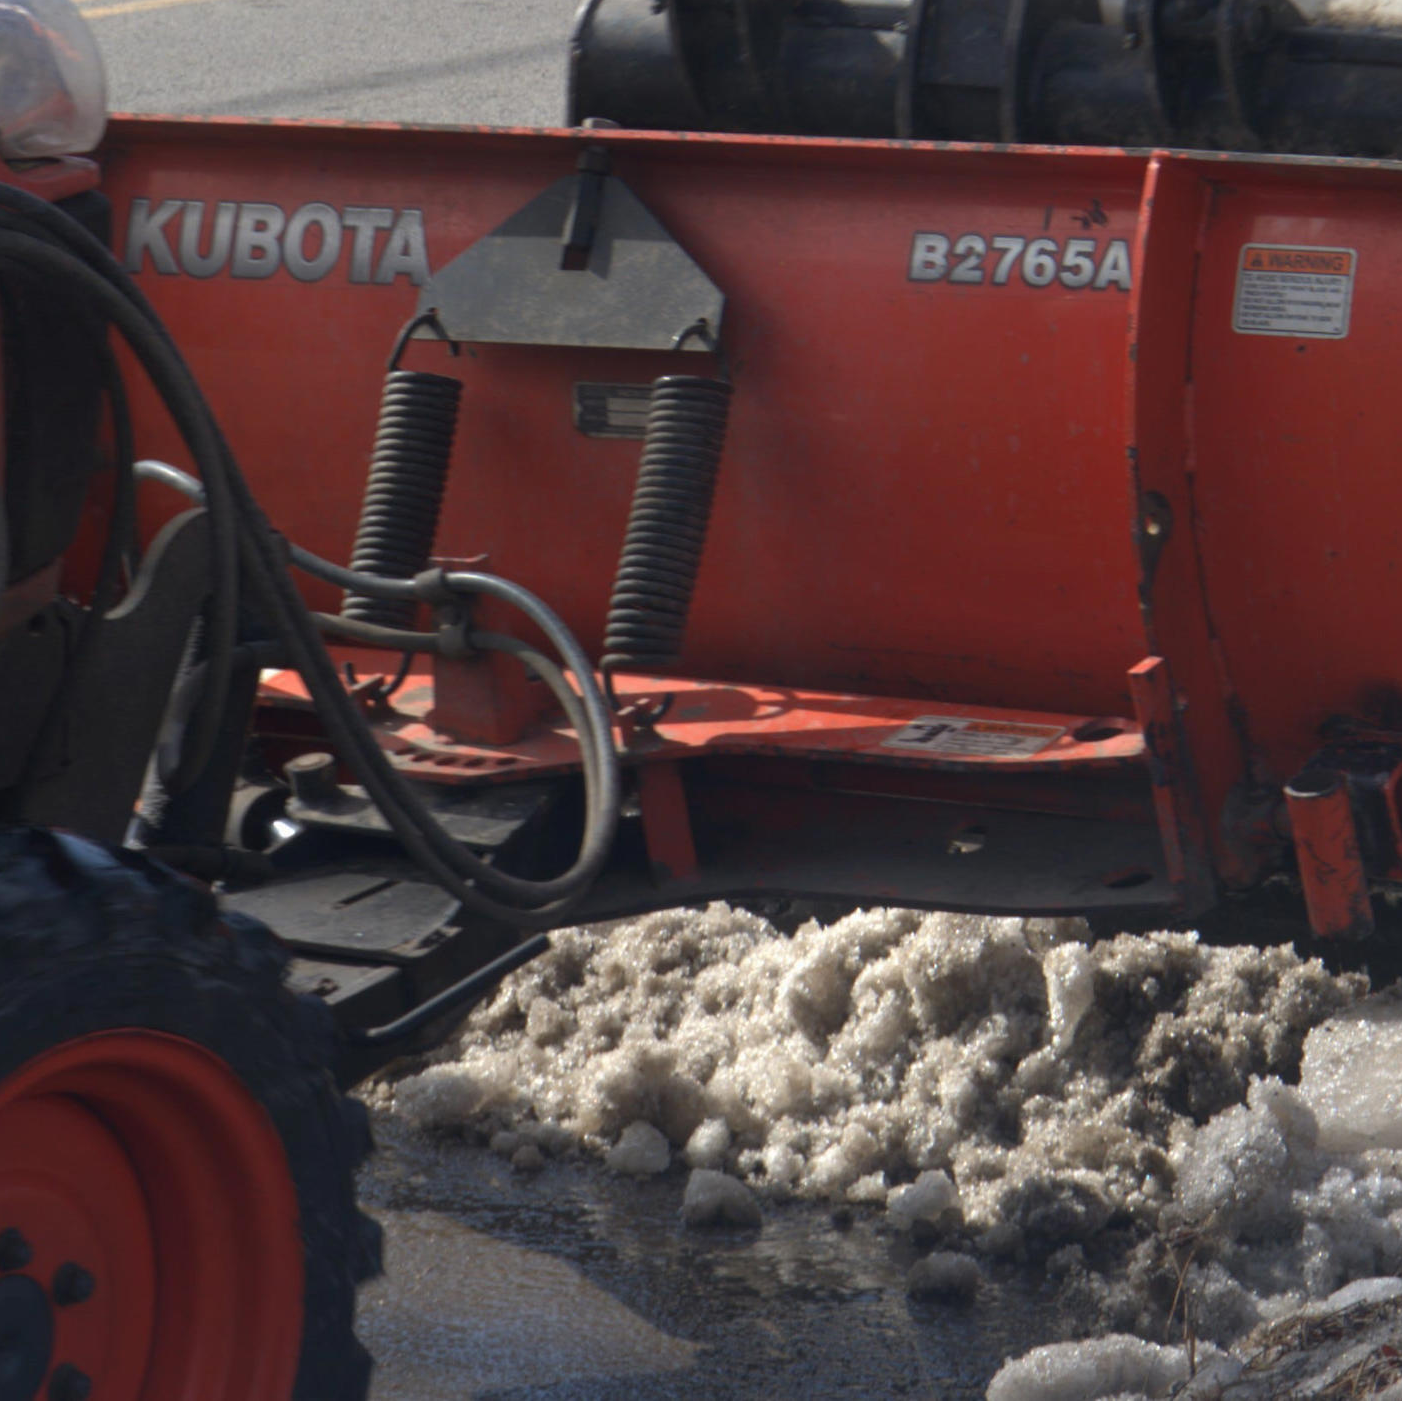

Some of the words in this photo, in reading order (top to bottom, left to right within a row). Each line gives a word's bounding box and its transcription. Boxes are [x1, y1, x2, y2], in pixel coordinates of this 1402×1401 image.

[125, 198, 431, 286] KUBOTA
[908, 231, 1132, 290] B2765A
[1268, 254, 1344, 271] WARNING
